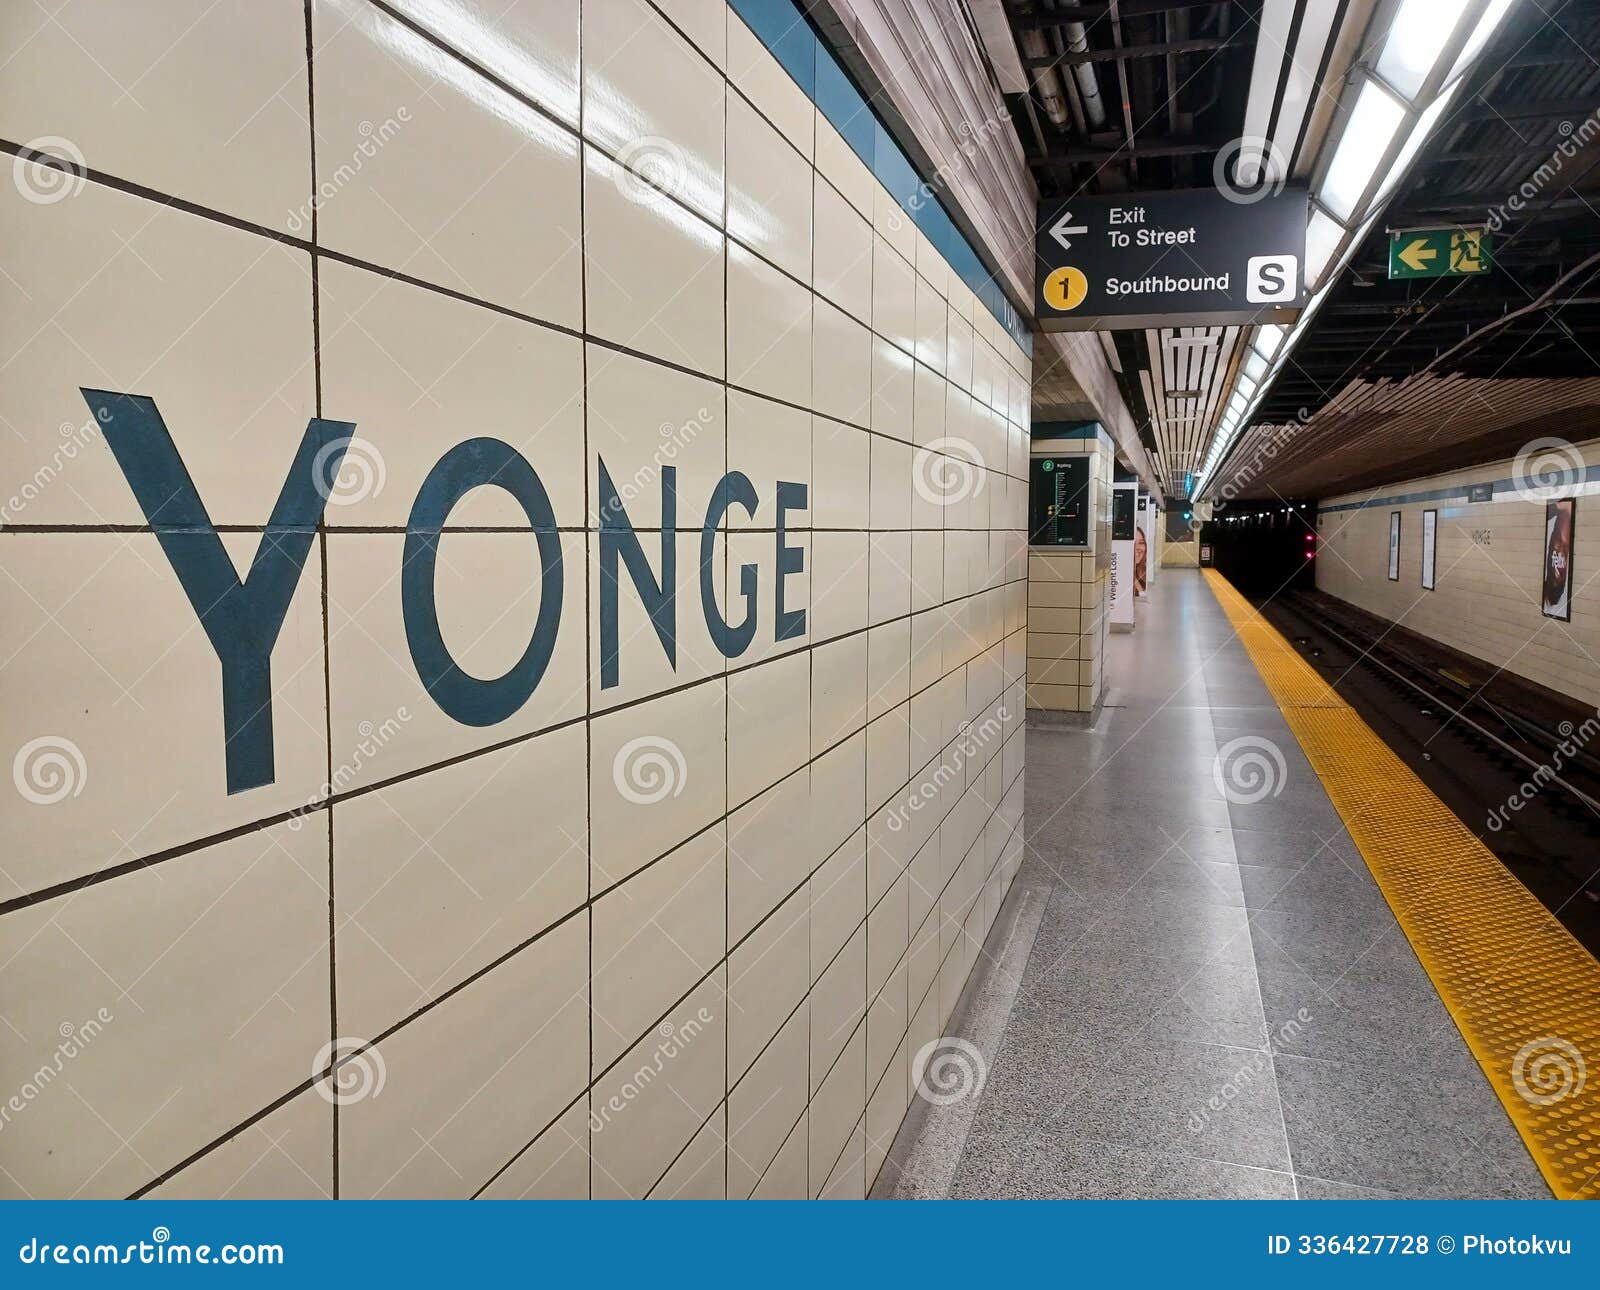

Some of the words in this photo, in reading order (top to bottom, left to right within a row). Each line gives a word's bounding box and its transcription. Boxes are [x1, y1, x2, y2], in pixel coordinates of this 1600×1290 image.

[1109, 207, 1146, 225] Exit
[1107, 230, 1130, 248] To
[1136, 227, 1196, 247] Street
[1058, 277, 1070, 300] 1
[1105, 272, 1230, 296] Southbound
[1257, 262, 1286, 296] S
[1110, 552, 1118, 571] Loss
[79, 387, 809, 796] YONGE
[1110, 572, 1118, 601] Weight
